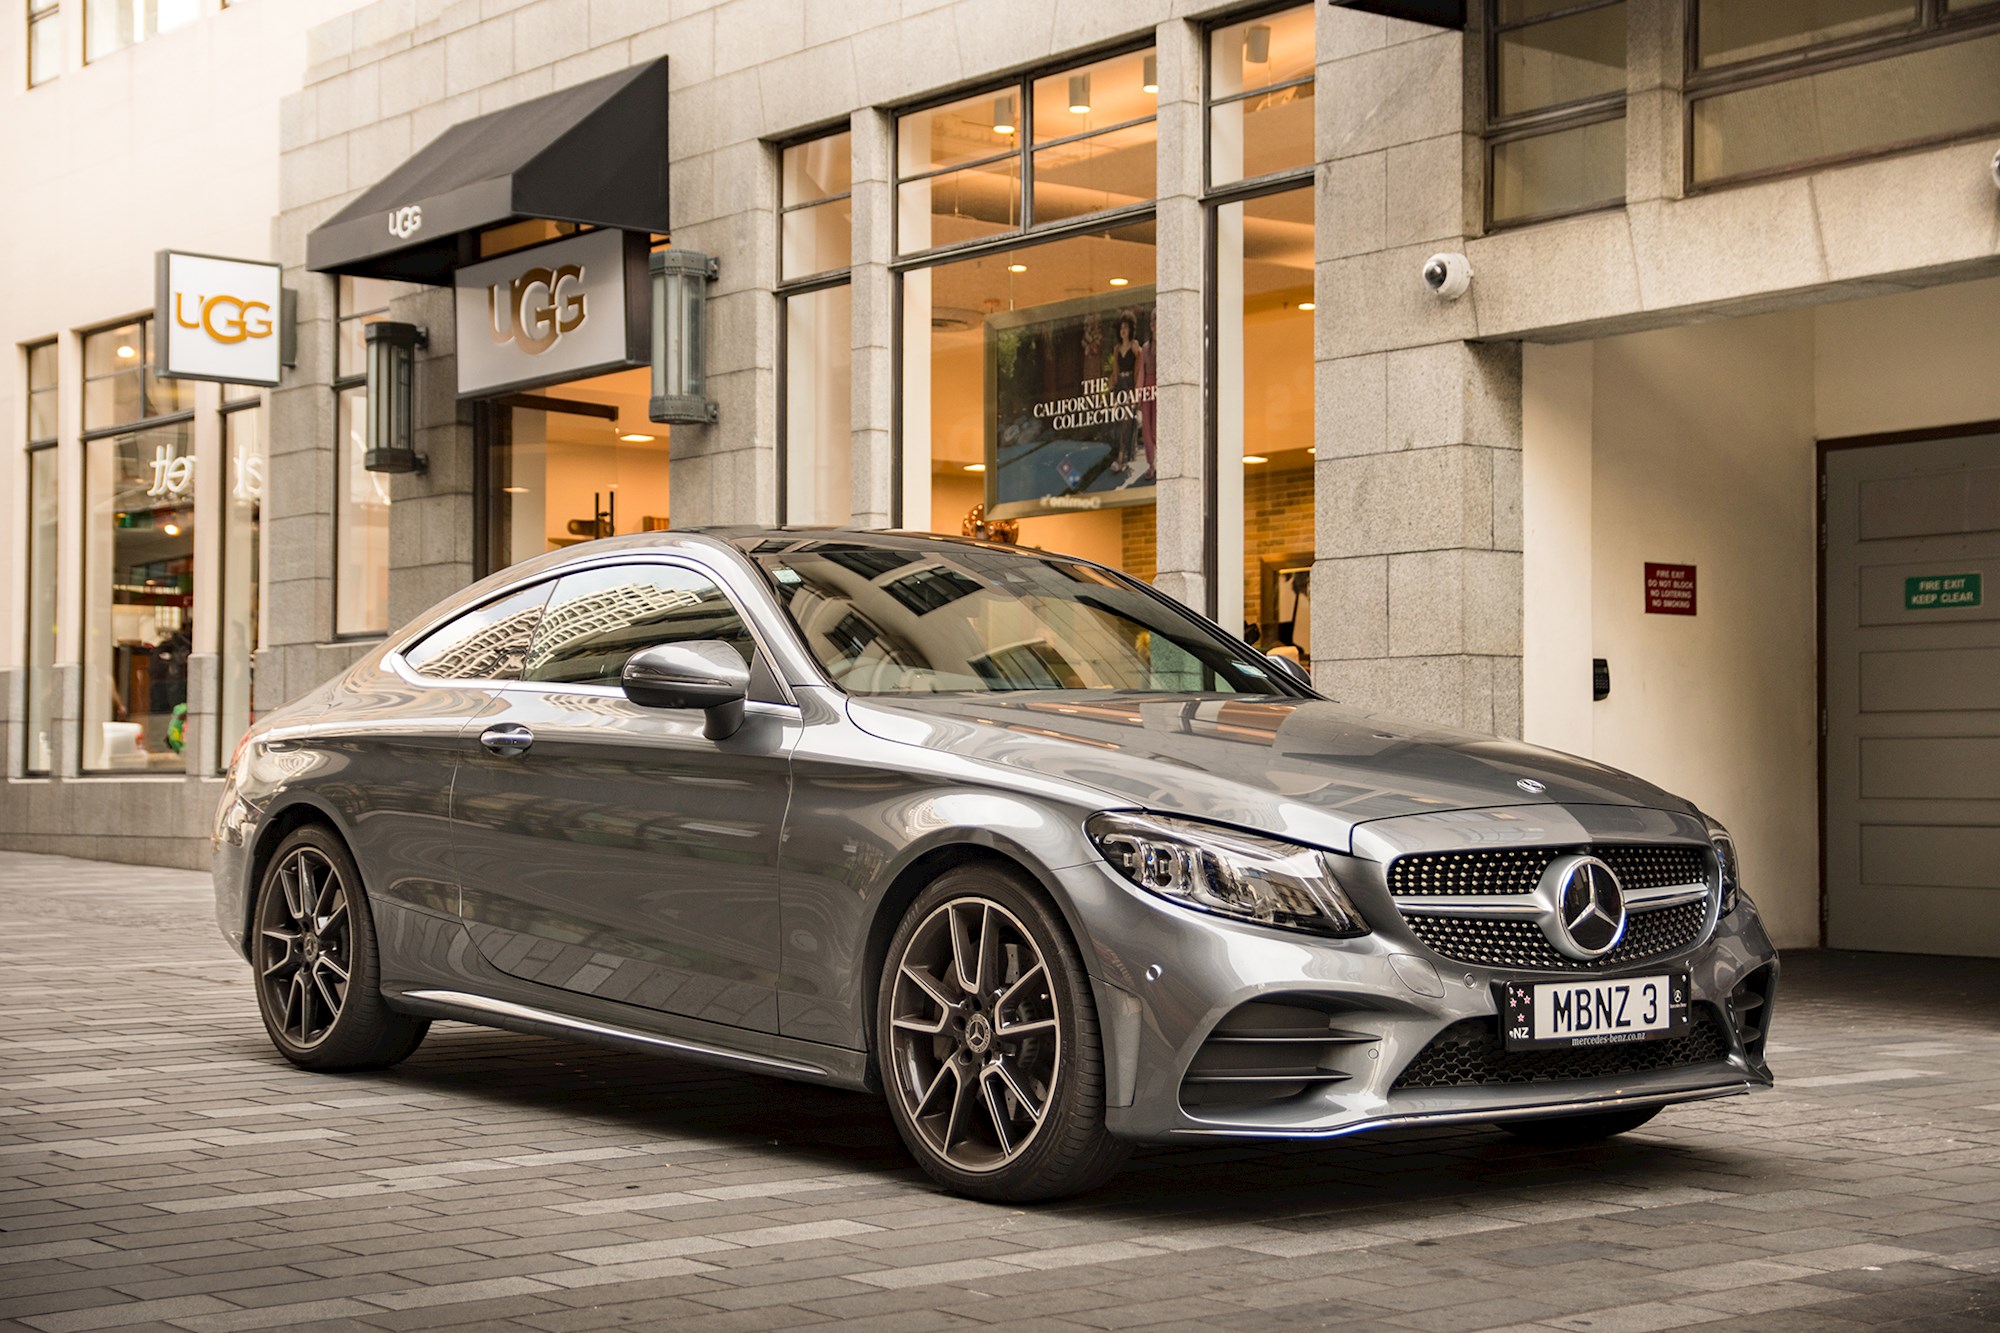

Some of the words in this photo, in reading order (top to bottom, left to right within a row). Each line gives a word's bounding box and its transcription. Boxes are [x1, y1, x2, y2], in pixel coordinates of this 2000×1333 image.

[388, 205, 422, 238] UGG
[175, 292, 273, 344] UGG
[487, 263, 588, 356] UGG
[1081, 377, 1109, 395] THE
[1033, 393, 1108, 418] CALIFORNIA
[1109, 385, 1157, 407] LOAFER
[1052, 405, 1138, 431] COLLECTION.
[1647, 579, 1658, 587] DO
[1659, 580, 1672, 588] NOT
[1673, 581, 1695, 589] BLOCK
[1650, 589, 1660, 597] NO
[1919, 580, 1940, 591] FIRE
[1943, 578, 1966, 590] EXIT
[1652, 599, 1662, 607] NO
[1911, 593, 1938, 604] KEEP
[1940, 591, 1974, 603] CLEAR
[1553, 984, 1631, 1032] MBNZ
[1642, 983, 1657, 1024] 3
[1571, 1032, 1646, 1046] mercedes-benz.co.nz
